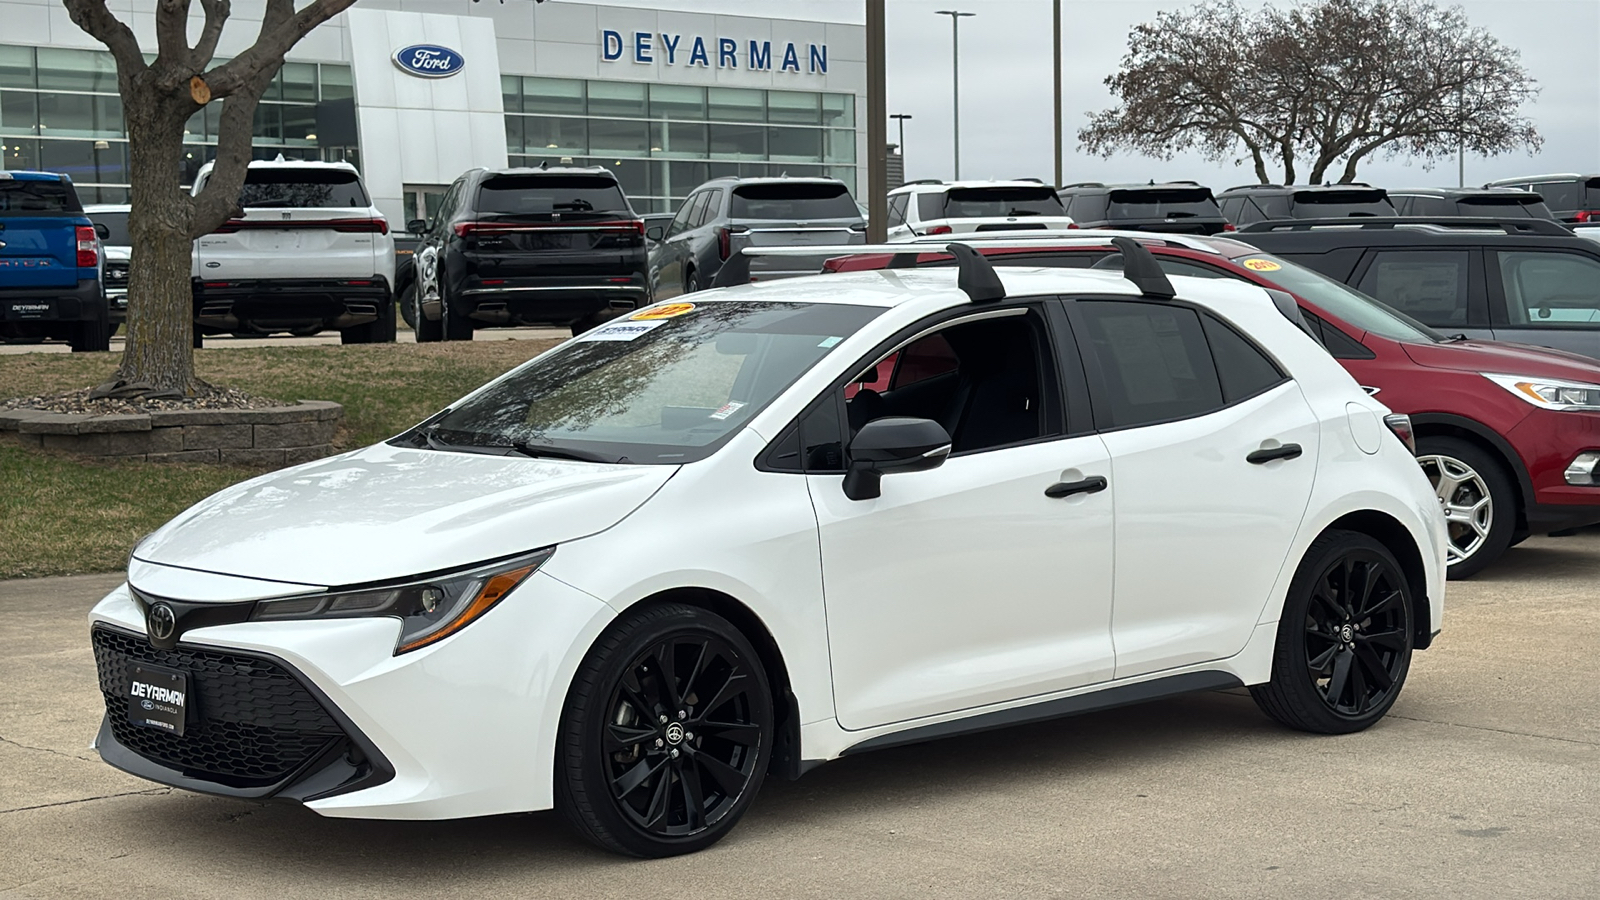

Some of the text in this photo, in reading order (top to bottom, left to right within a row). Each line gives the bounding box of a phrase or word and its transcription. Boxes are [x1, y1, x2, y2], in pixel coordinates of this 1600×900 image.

[412, 49, 451, 70] Ford
[602, 29, 828, 74] DEYARMAN
[131, 681, 184, 707] DEYARMAN
